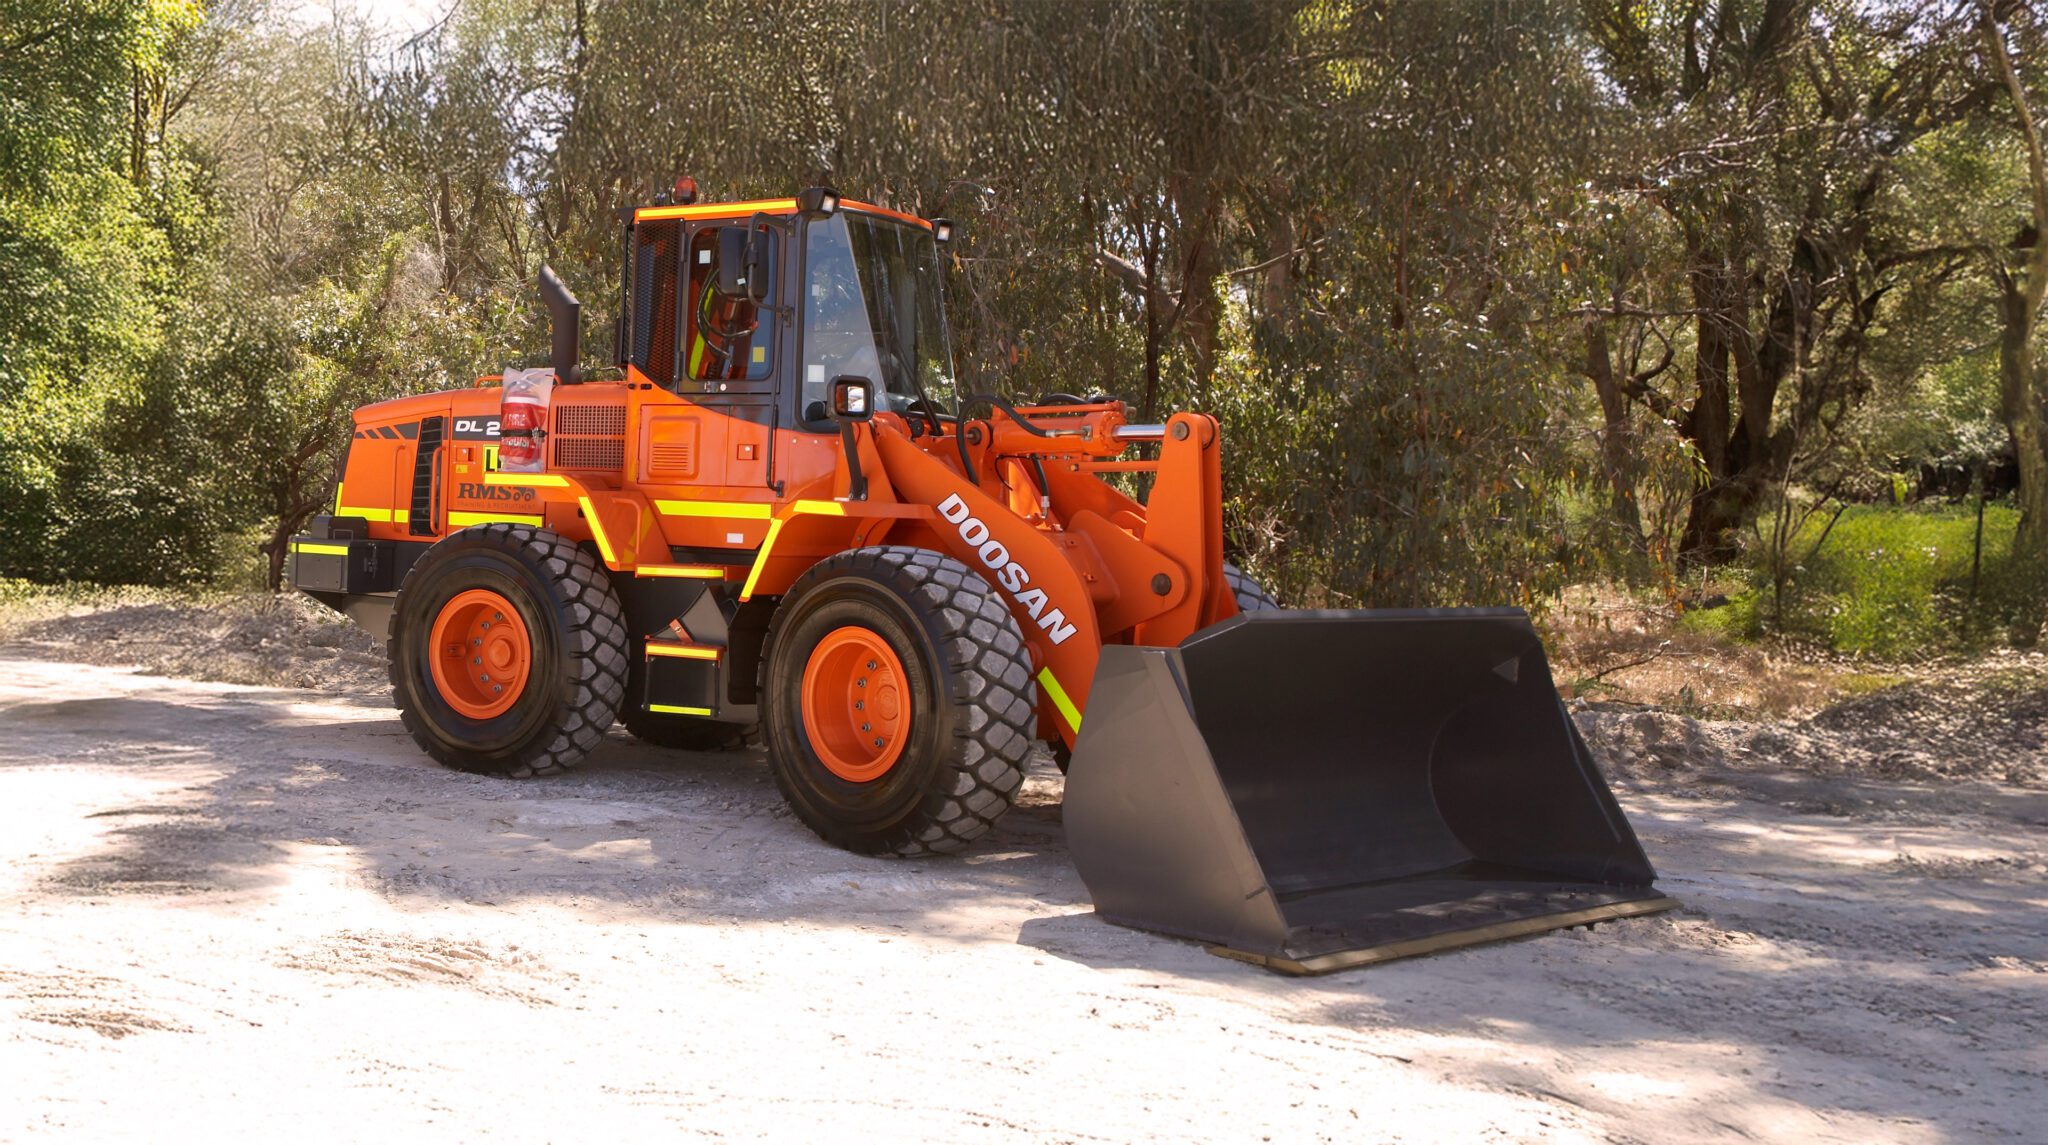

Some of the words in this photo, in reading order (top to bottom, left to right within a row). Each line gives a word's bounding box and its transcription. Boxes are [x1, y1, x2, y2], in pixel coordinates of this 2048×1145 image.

[455, 420, 483, 432] DL
[457, 483, 512, 500] RMS
[936, 492, 1079, 646] DOOSAN
